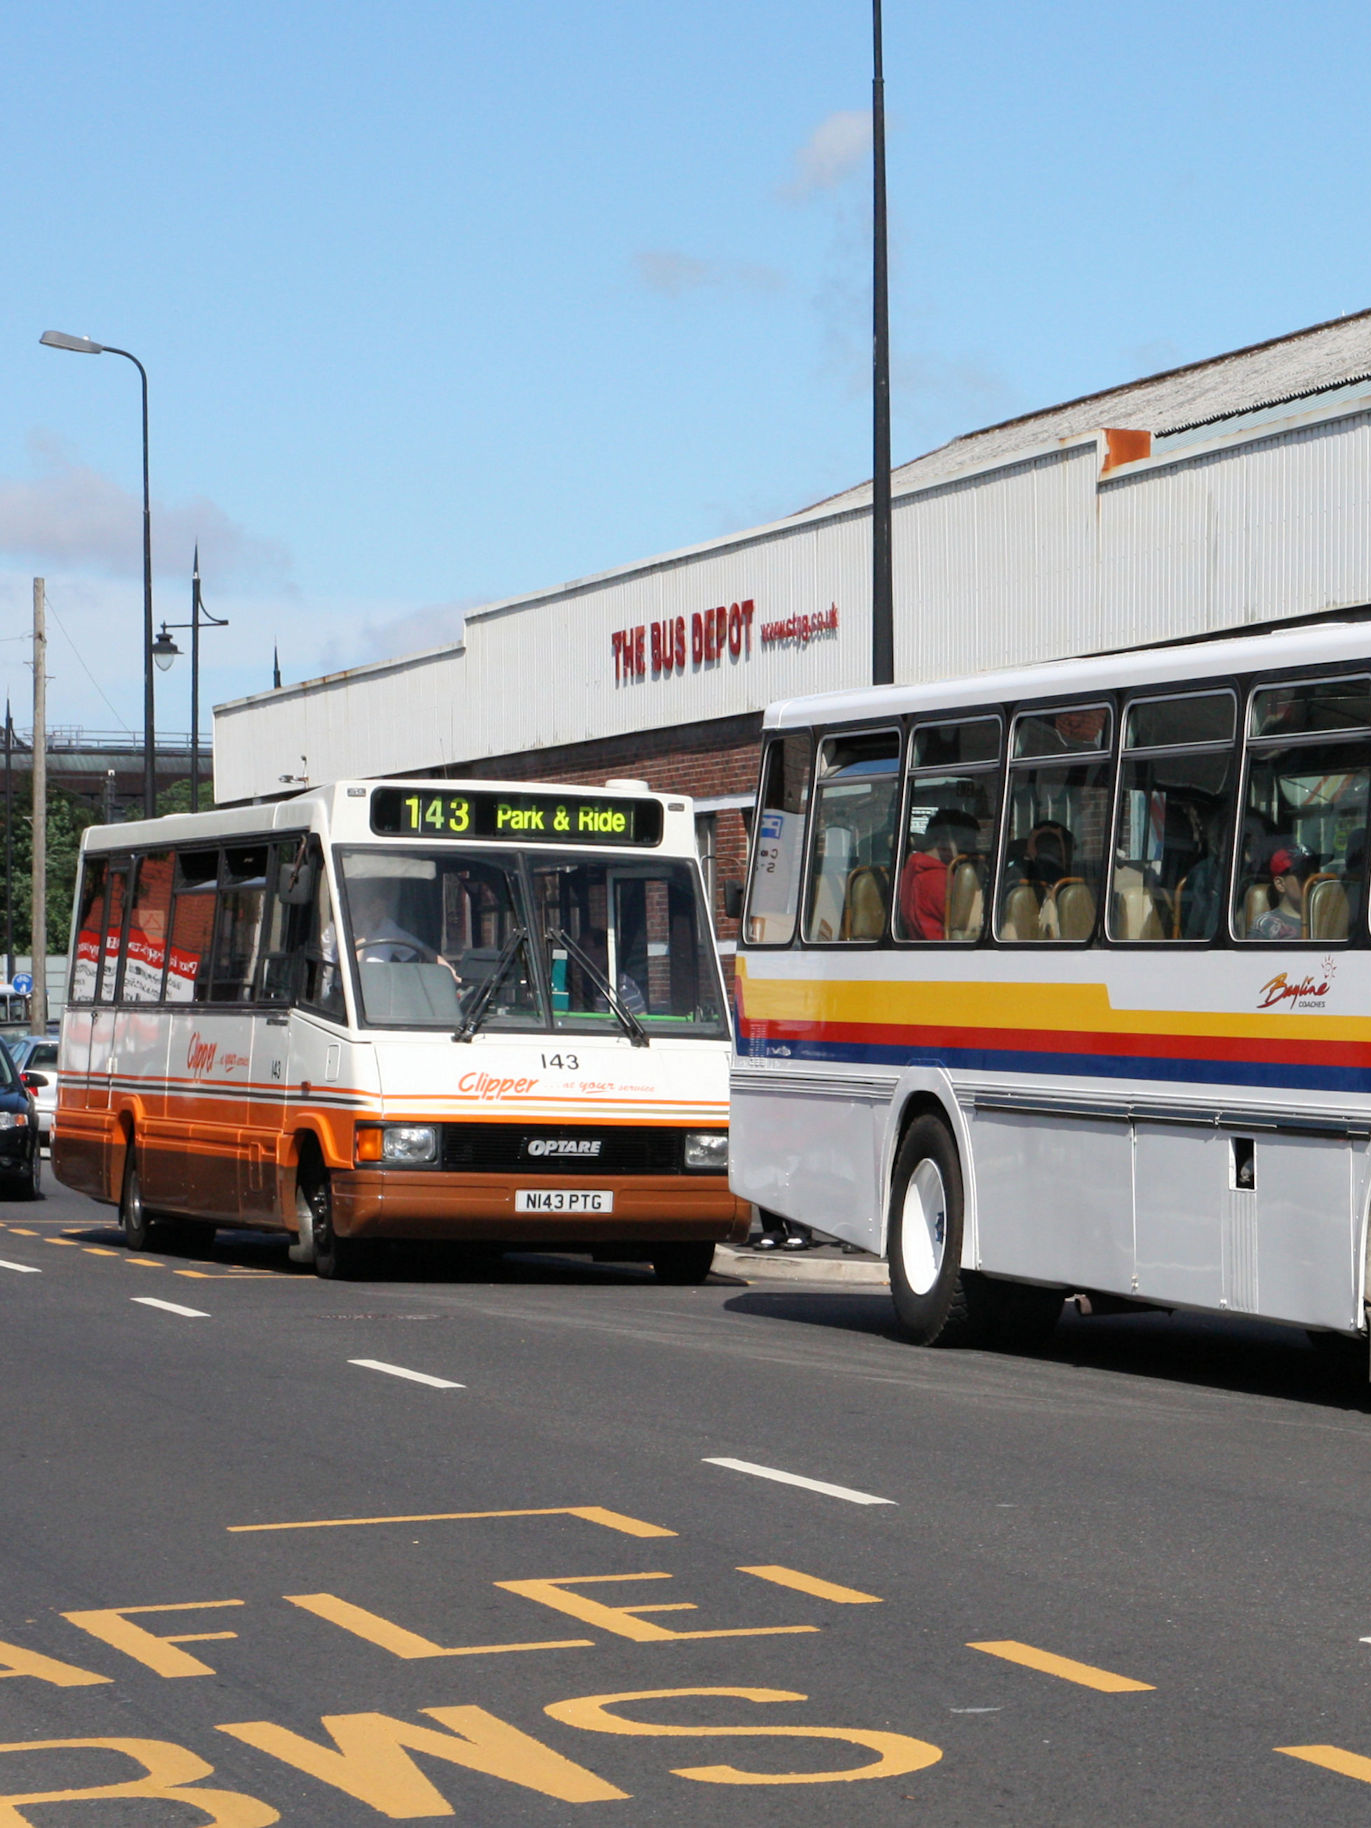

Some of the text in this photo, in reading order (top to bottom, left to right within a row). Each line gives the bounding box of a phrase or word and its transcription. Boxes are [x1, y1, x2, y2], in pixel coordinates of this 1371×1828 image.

[611, 625, 646, 682] THE
[650, 615, 686, 673] BUS
[692, 598, 754, 665] DEPOT
[405, 794, 626, 832] 143 Park & Ride
[541, 1053, 580, 1071] 143
[458, 1072, 540, 1101] Clipper
[579, 1081, 615, 1094] your
[528, 1140, 601, 1156] OPTARE
[526, 1193, 602, 1210] N143 PTG
